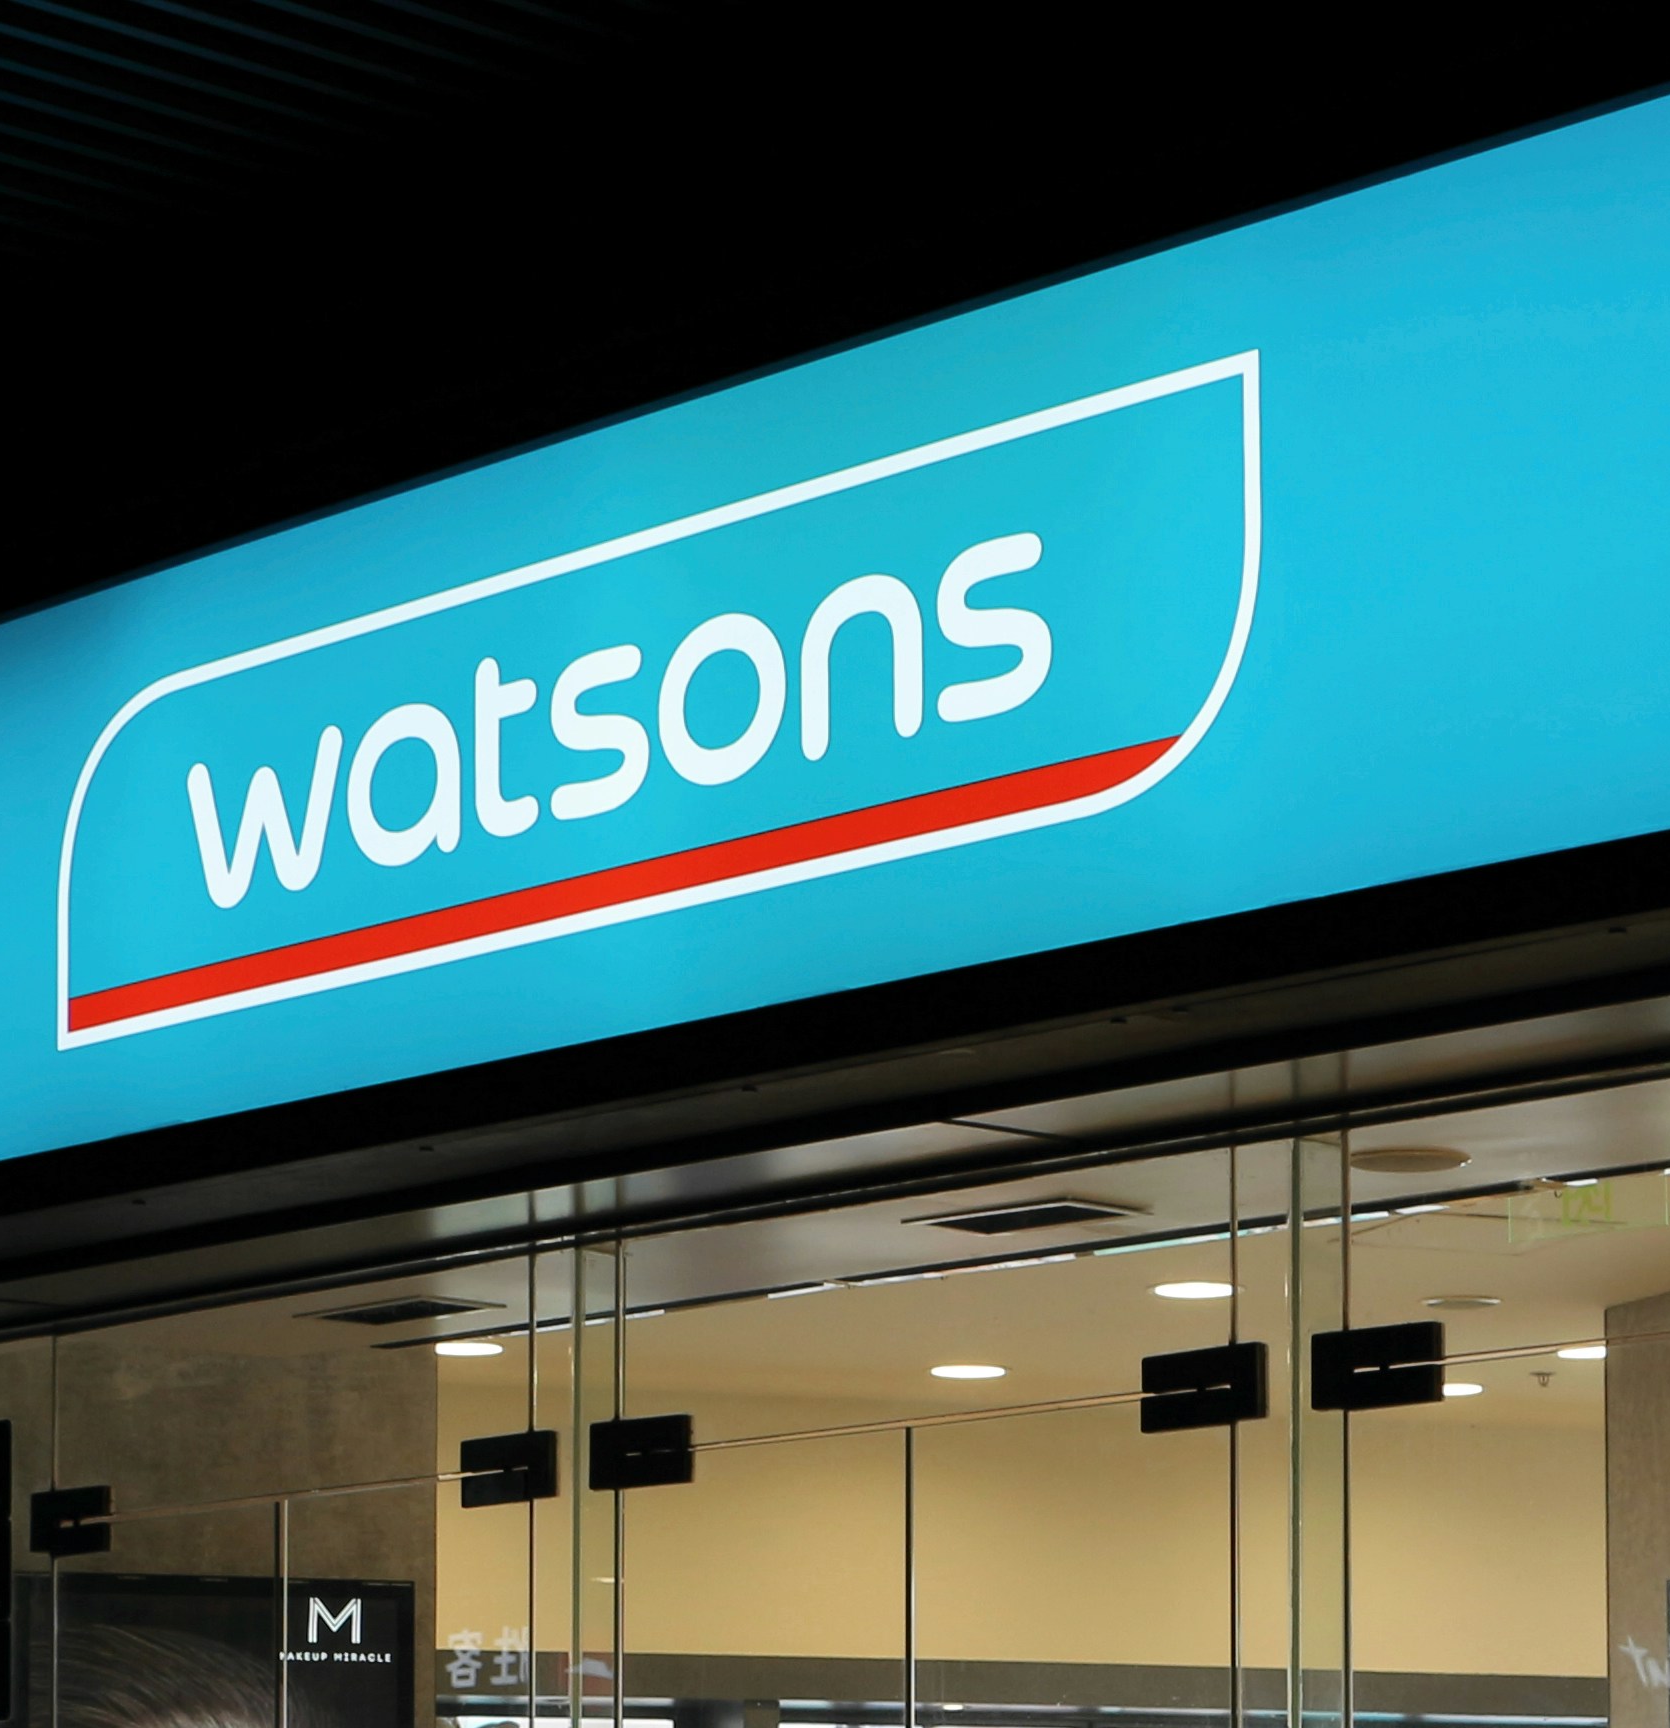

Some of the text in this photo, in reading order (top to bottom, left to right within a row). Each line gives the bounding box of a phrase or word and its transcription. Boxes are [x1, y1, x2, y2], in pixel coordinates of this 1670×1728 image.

[188, 532, 1053, 908] watsons
[308, 1597, 362, 1644] M
[334, 1651, 392, 1663] MIRACLE
